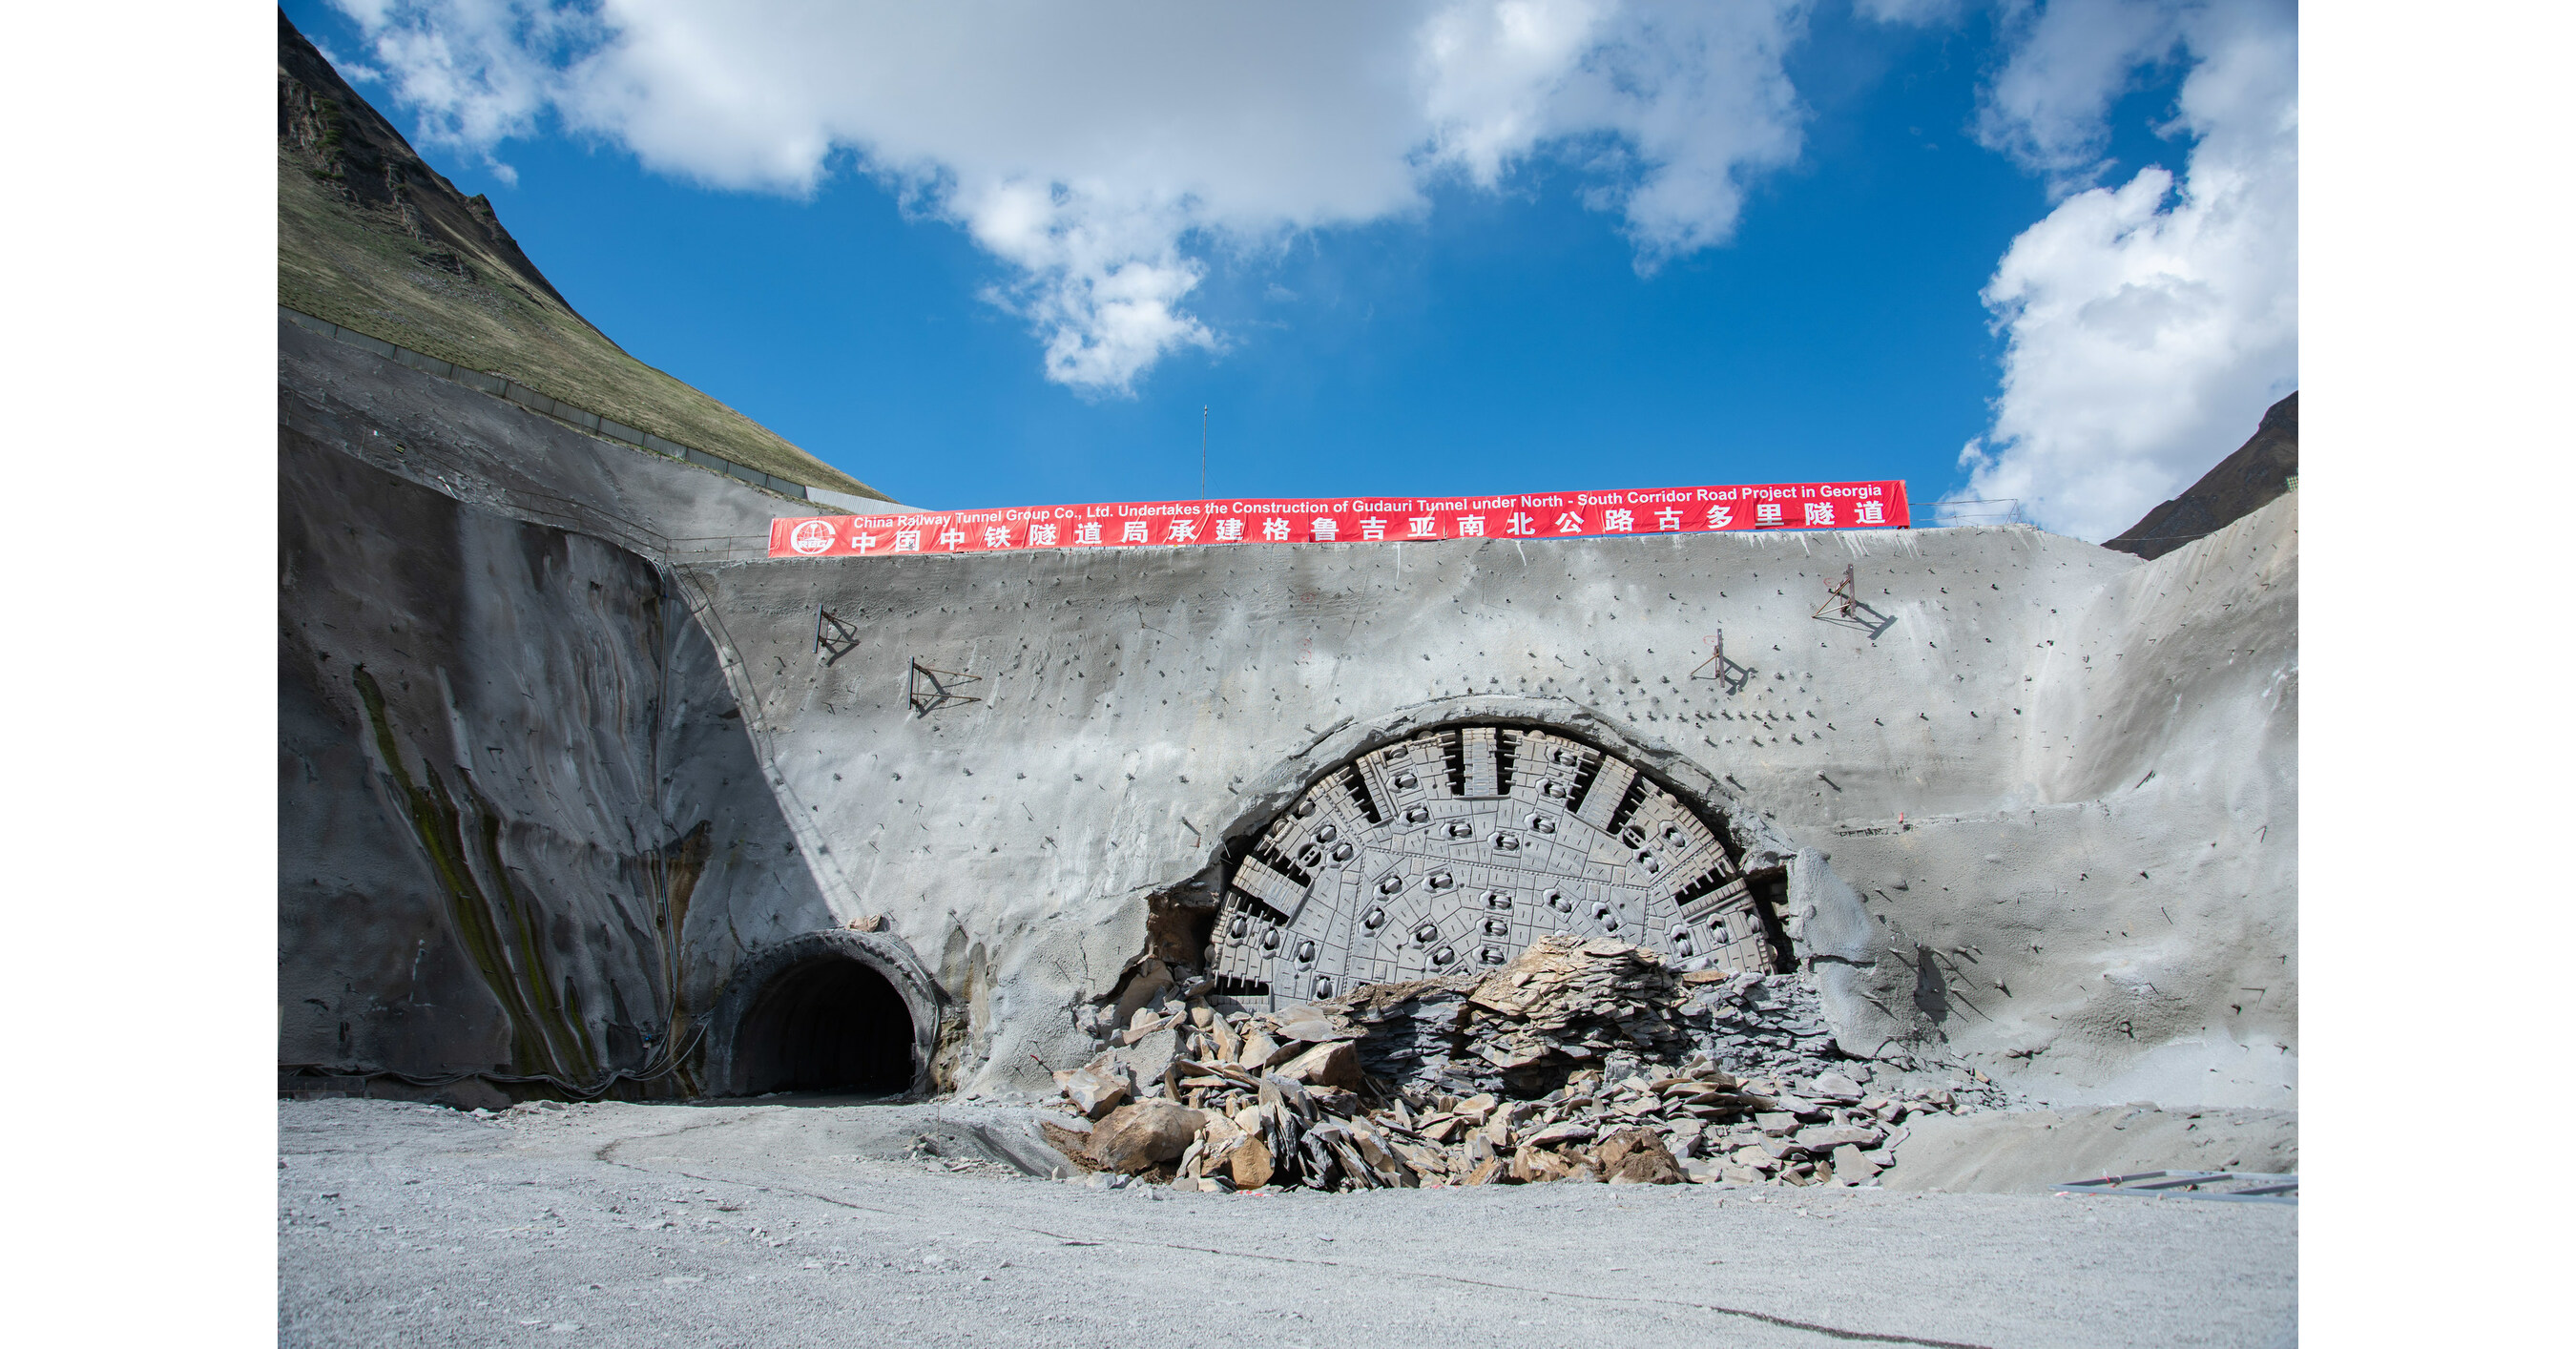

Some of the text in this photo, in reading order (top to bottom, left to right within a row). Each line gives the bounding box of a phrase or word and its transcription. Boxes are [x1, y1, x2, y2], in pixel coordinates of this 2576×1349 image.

[851, 500, 1886, 554] 中国中铁隧道局承建格鲁吉亚南北公路古多里隧道
[854, 517, 893, 529] China
[898, 514, 951, 528] Railway
[957, 511, 1002, 524] Tunnel
[1006, 509, 1049, 522] Group
[1054, 508, 1082, 520] Co.,
[1087, 506, 1113, 518] Ltd.
[1118, 504, 1200, 517] Undertakes
[1204, 503, 1228, 514] the
[1233, 501, 1328, 513] Construction
[1333, 500, 1348, 512] of
[1353, 499, 1412, 512] Gudauri
[1416, 499, 1467, 511] Tunnel
[1472, 498, 1517, 509] under
[1521, 494, 1563, 508] North
[1578, 492, 1623, 506] South
[1628, 489, 1693, 504] Corridor
[1696, 488, 1737, 501] Road
[1742, 486, 1797, 501] Project
[1801, 486, 1816, 498] in
[1819, 484, 1882, 499] Georgia
